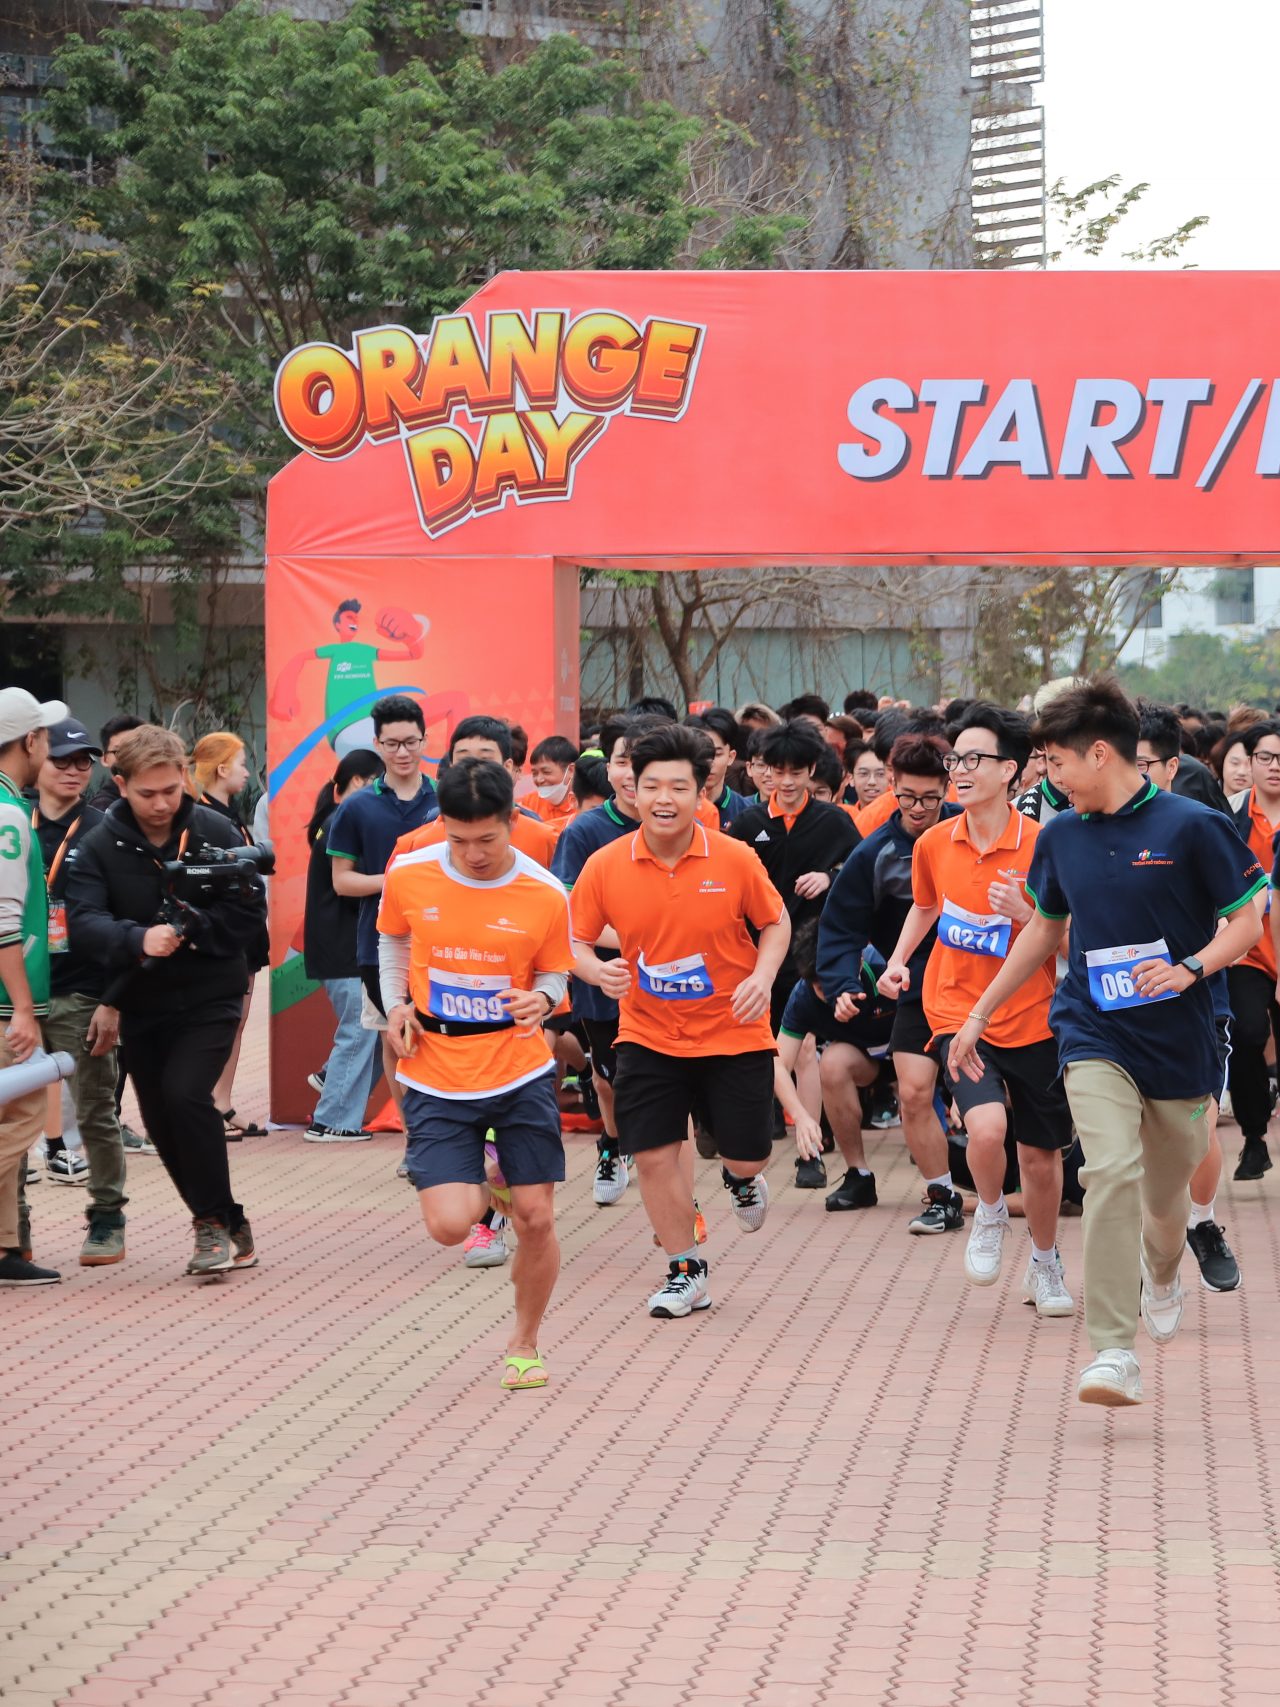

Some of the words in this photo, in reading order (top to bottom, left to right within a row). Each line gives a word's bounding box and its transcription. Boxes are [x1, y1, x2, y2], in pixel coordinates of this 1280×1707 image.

[276, 311, 704, 459] ORANGE
[405, 412, 605, 534] DAY
[948, 925, 1000, 953] 0271
[441, 992, 504, 1020] 0089
